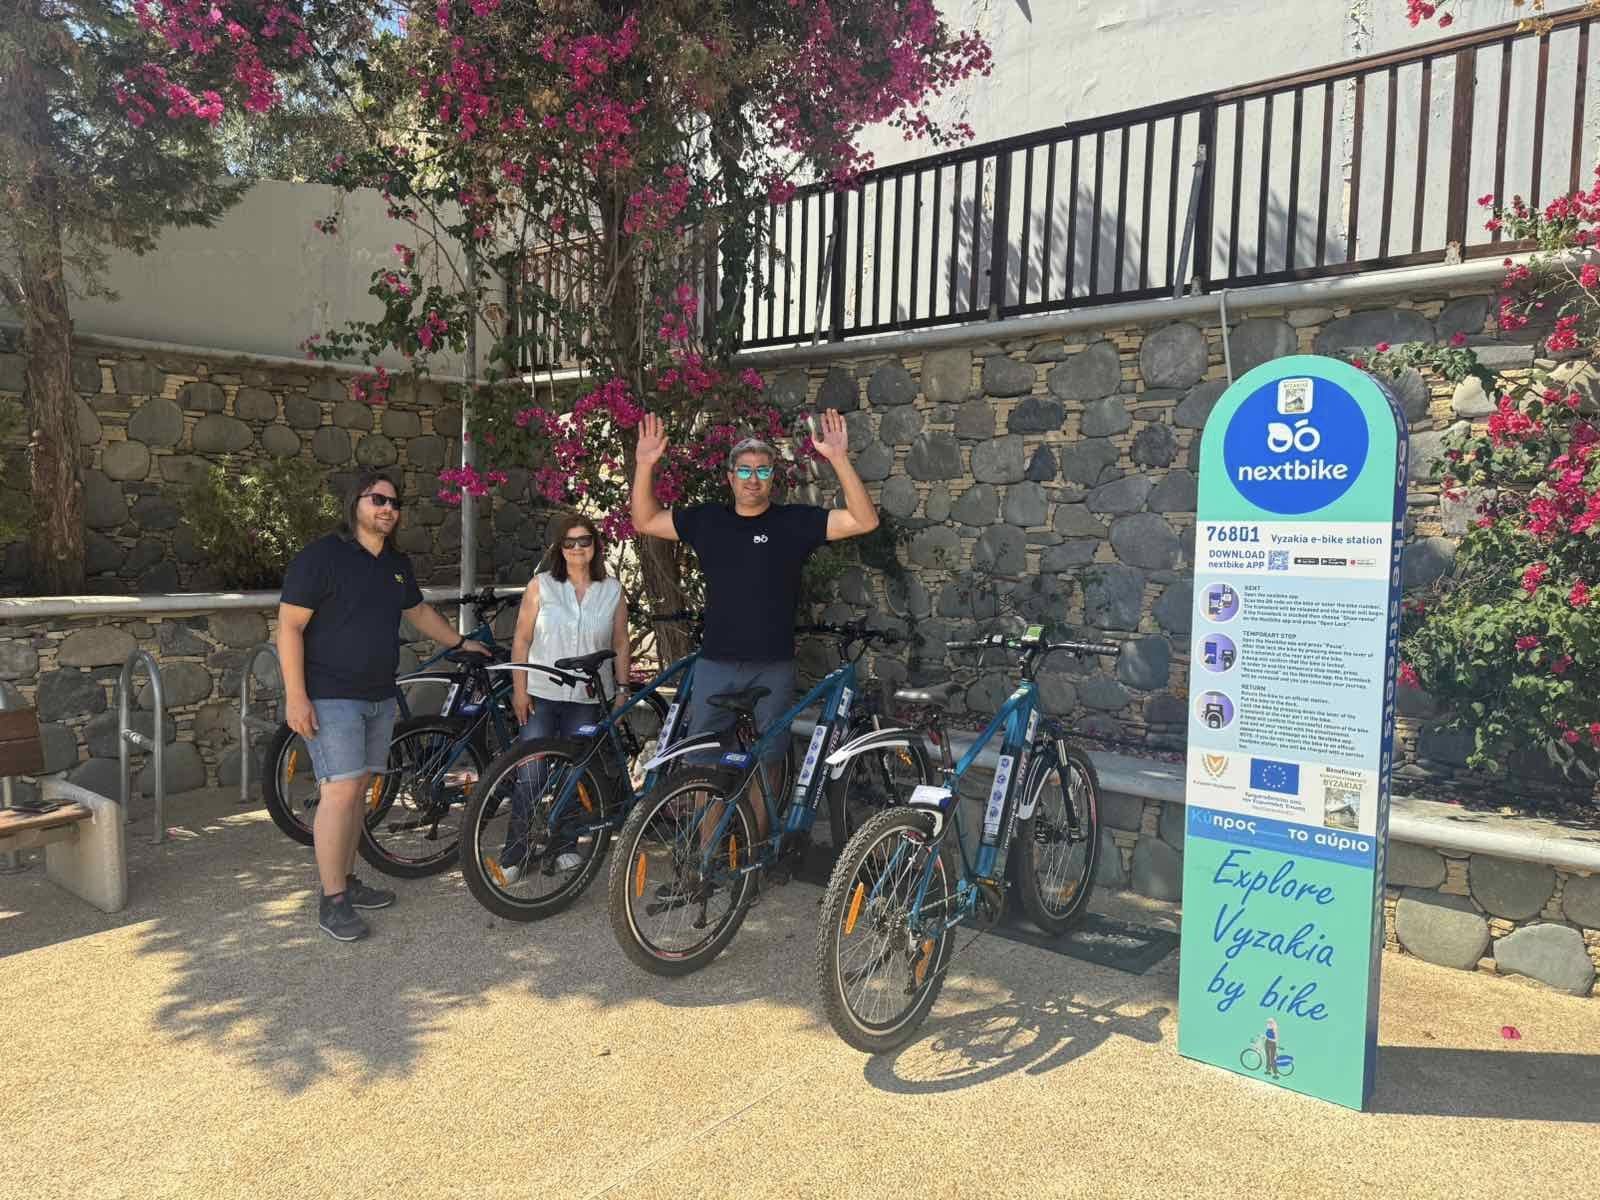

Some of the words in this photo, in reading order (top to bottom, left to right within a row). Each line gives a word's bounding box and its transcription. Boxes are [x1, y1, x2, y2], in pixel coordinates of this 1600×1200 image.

[1238, 459, 1348, 481] nextbike
[1207, 526, 1260, 542] 76801
[1209, 550, 1265, 559] DOWNLOAD
[1271, 533, 1309, 546] Vyzakia
[1311, 534, 1344, 545] e-bike
[1346, 535, 1383, 546] station
[1391, 517, 1406, 587] The
[1208, 560, 1244, 569] nextbike
[1246, 561, 1265, 569] APP
[1384, 600, 1400, 739] streets
[1379, 752, 1390, 816] are
[1191, 808, 1257, 835] Κύπρος
[1287, 828, 1309, 841] το
[1314, 832, 1370, 852] αύριο
[1213, 849, 1335, 905] Explore
[1213, 903, 1335, 967] Vyzakia
[1207, 961, 1246, 1012] by
[1260, 975, 1329, 1021] bike
